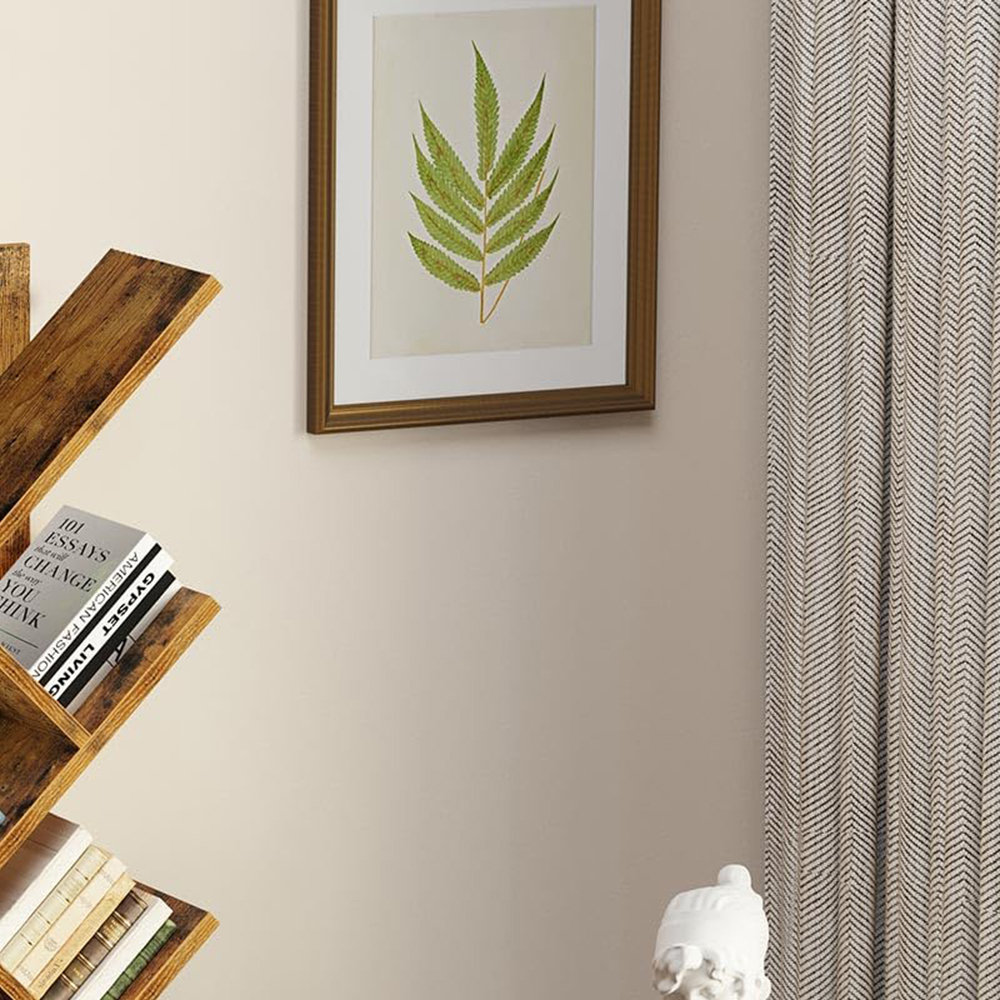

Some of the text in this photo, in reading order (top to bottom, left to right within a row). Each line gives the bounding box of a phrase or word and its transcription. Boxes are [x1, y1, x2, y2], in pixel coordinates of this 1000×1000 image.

[58, 517, 85, 535] 101
[44, 531, 111, 564] ESSAYS
[0, 579, 41, 603] YOU
[23, 556, 98, 593] CHANGE
[32, 552, 140, 678] AMERICAN FASHION
[48, 572, 155, 697] GYPSET LIVING
